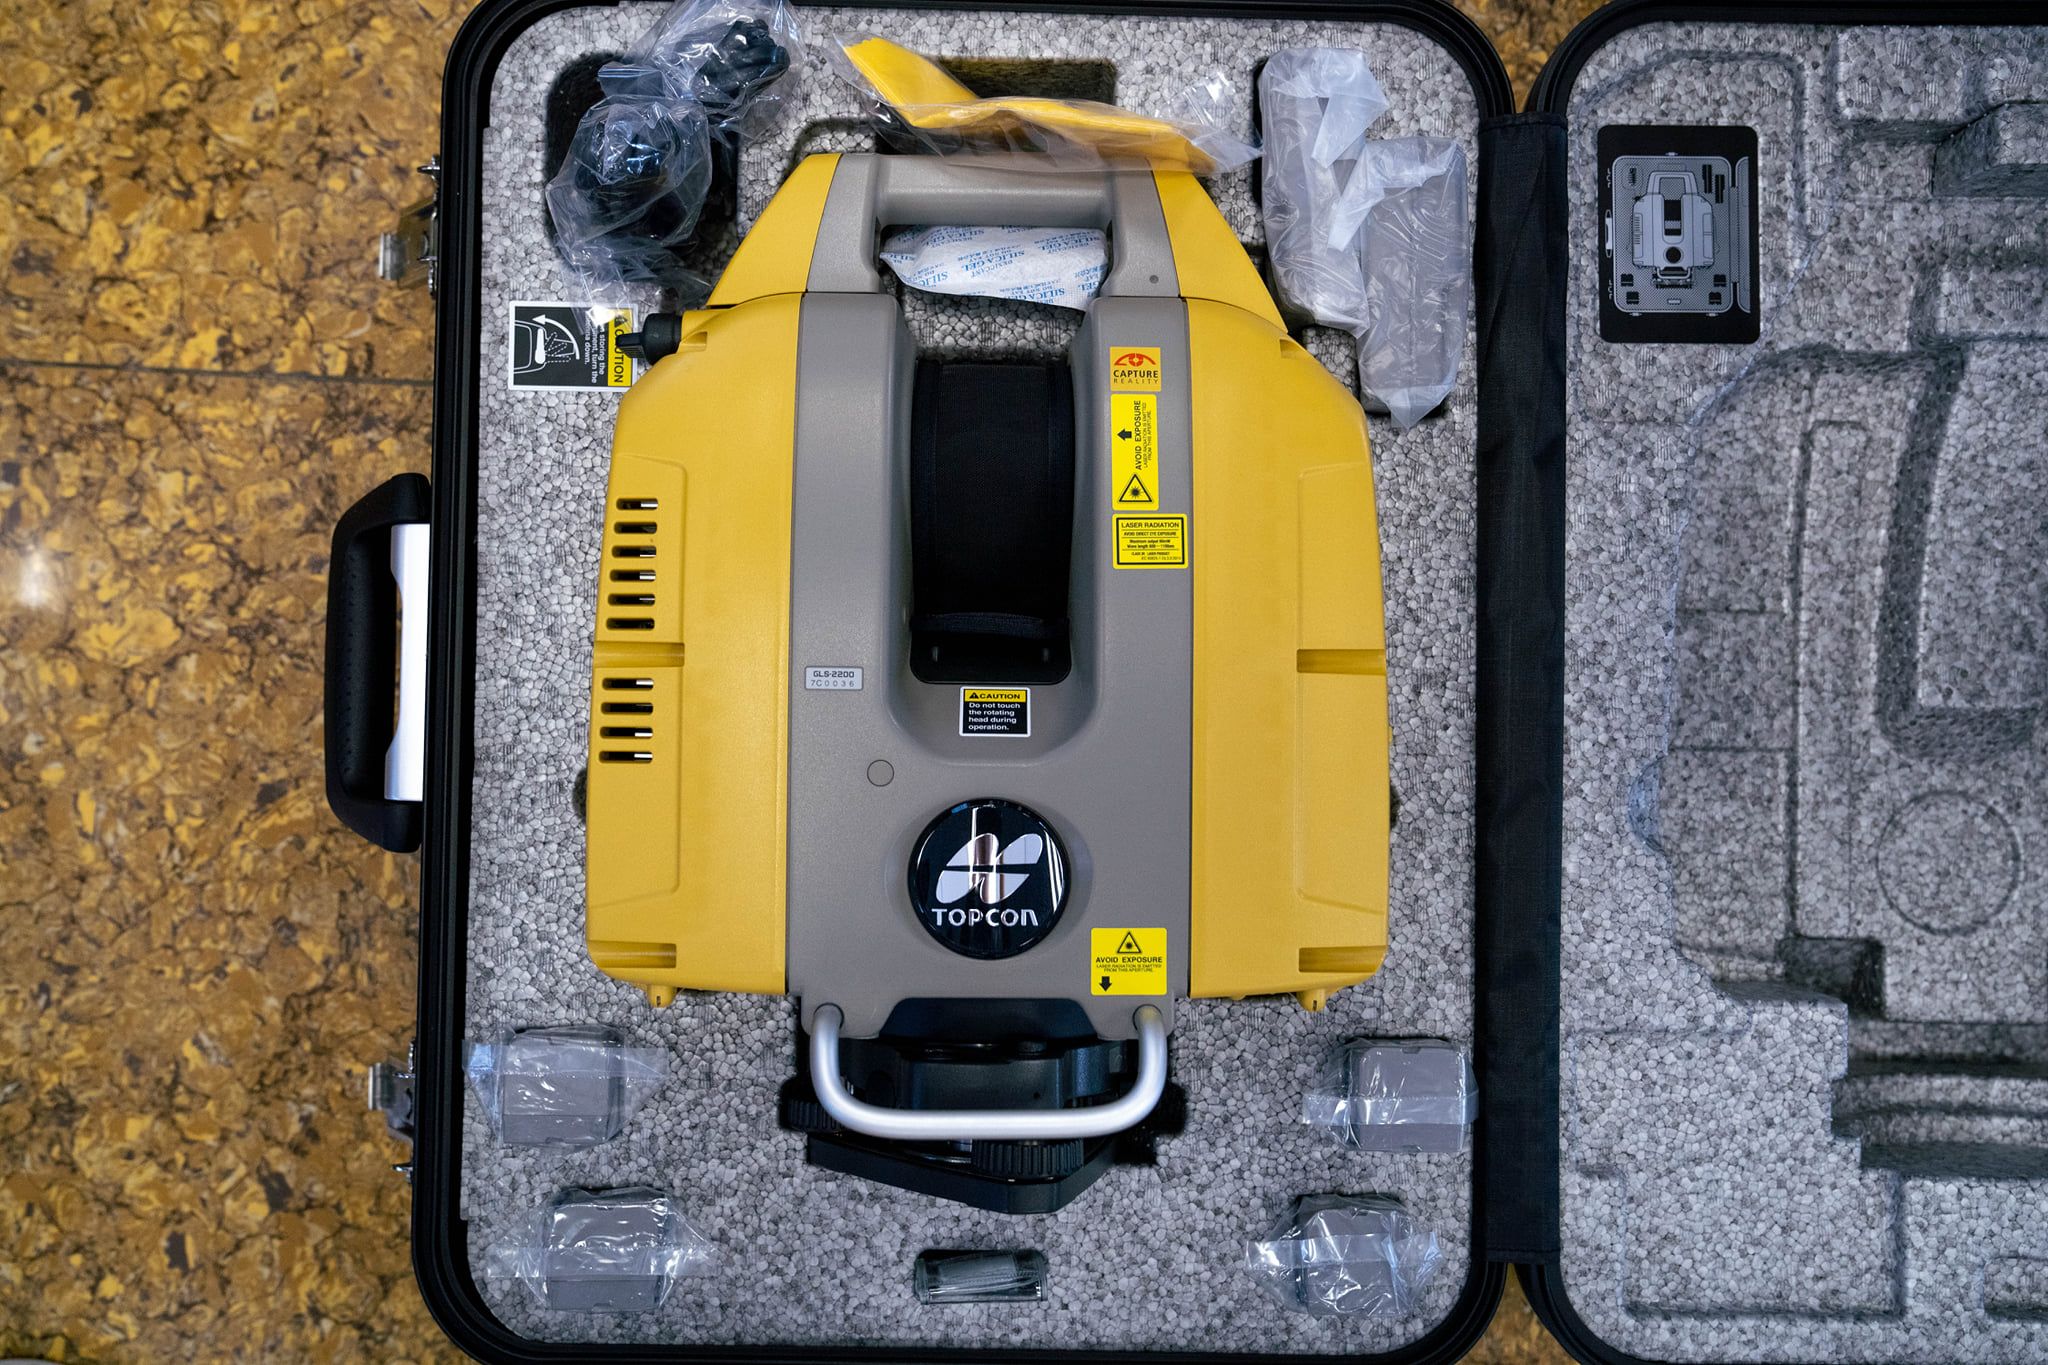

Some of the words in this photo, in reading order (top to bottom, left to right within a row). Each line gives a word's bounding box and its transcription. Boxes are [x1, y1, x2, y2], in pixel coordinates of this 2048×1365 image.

[986, 250, 1025, 264] SILICA
[961, 260, 985, 271] GEL
[1028, 288, 1065, 300] SILICA
[597, 334, 606, 361] storing
[614, 329, 625, 383] CUTION
[591, 371, 599, 384] the
[1113, 369, 1159, 378] CAPTURE
[1134, 400, 1142, 443] EXPOSURE
[1135, 445, 1143, 470] AVOID
[813, 670, 855, 678] GLS-2200
[931, 908, 1039, 927] TOPCON
